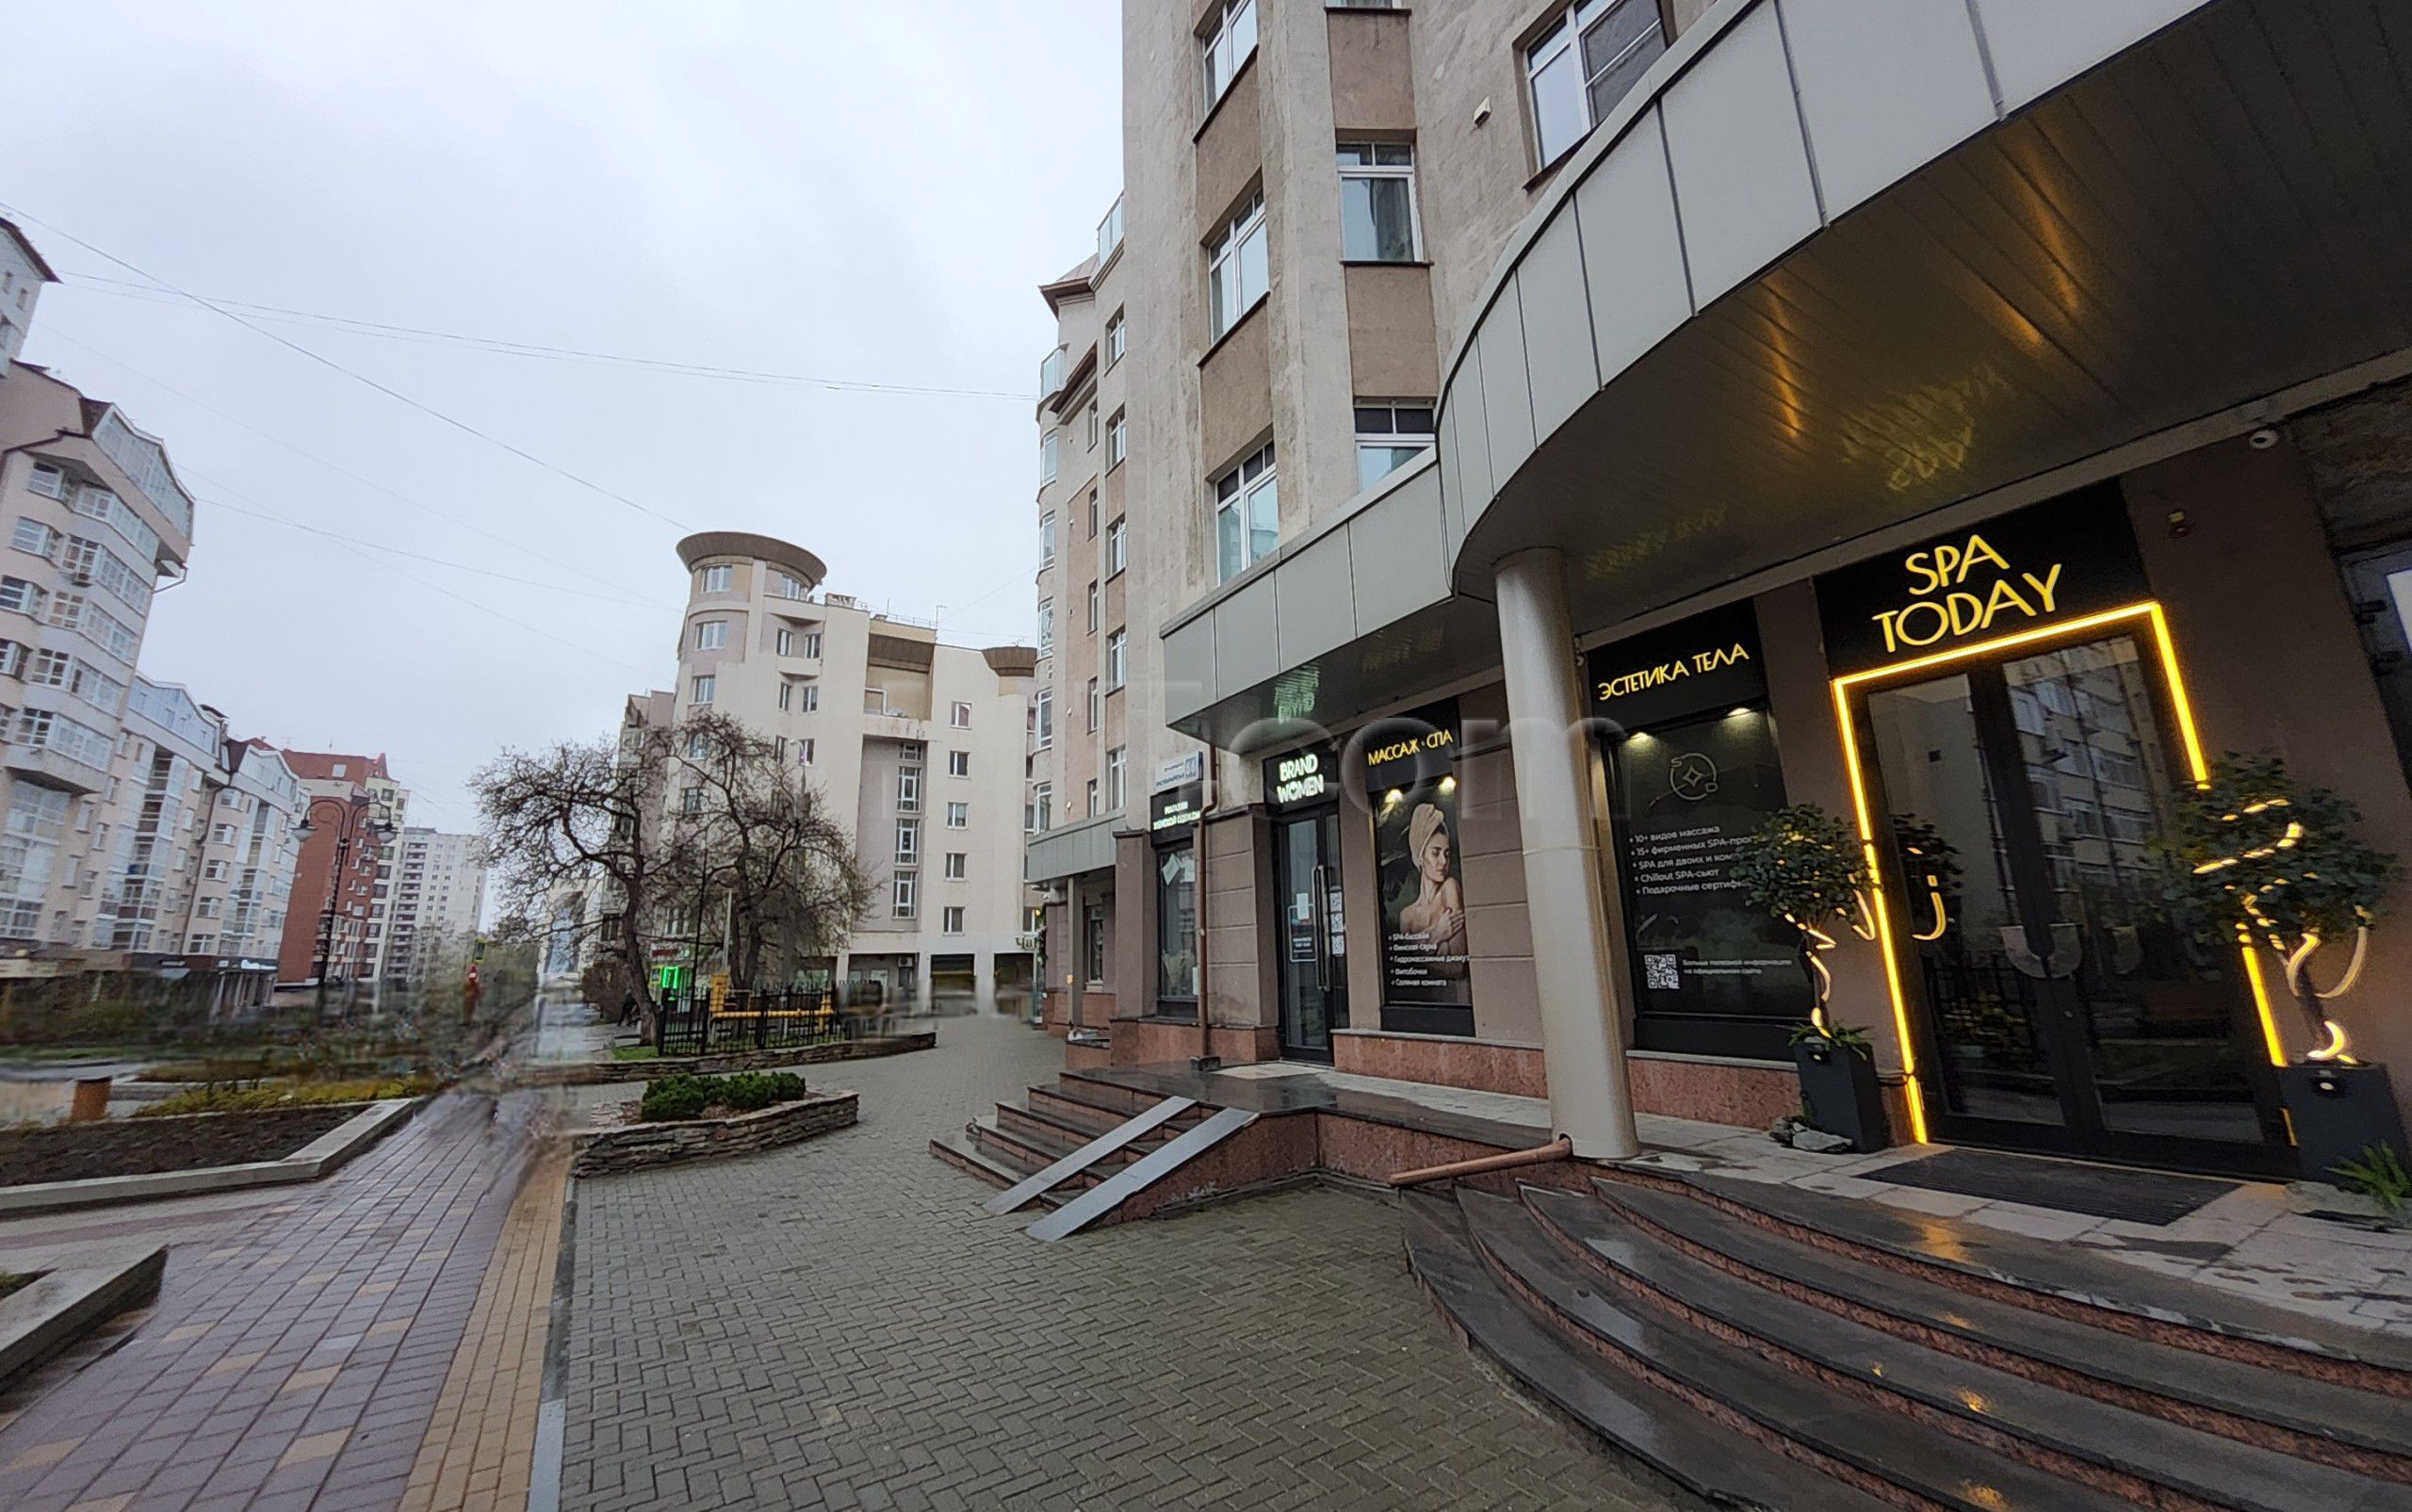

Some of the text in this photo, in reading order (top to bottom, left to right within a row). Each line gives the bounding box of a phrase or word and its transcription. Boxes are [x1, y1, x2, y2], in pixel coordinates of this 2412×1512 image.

[1905, 534, 2011, 595] SPA
[1871, 563, 2062, 653] TODAY
[1597, 642, 1750, 701] ЭСТЕТИКА ТЕЛА
[1367, 728, 1453, 767] МАССАЖ СПА
[1279, 754, 1318, 781] BRAND
[1277, 773, 1324, 803] WOMEN
[1651, 831, 1677, 841] видов
[1679, 826, 1720, 837] массажа
[1651, 842, 1706, 855] фирменных
[1638, 860, 1656, 870] SPA
[1657, 859, 1674, 869] для
[1675, 855, 1704, 867] двоих
[1640, 872, 1674, 883] Chillout
[1642, 884, 1700, 896] Подарочные
